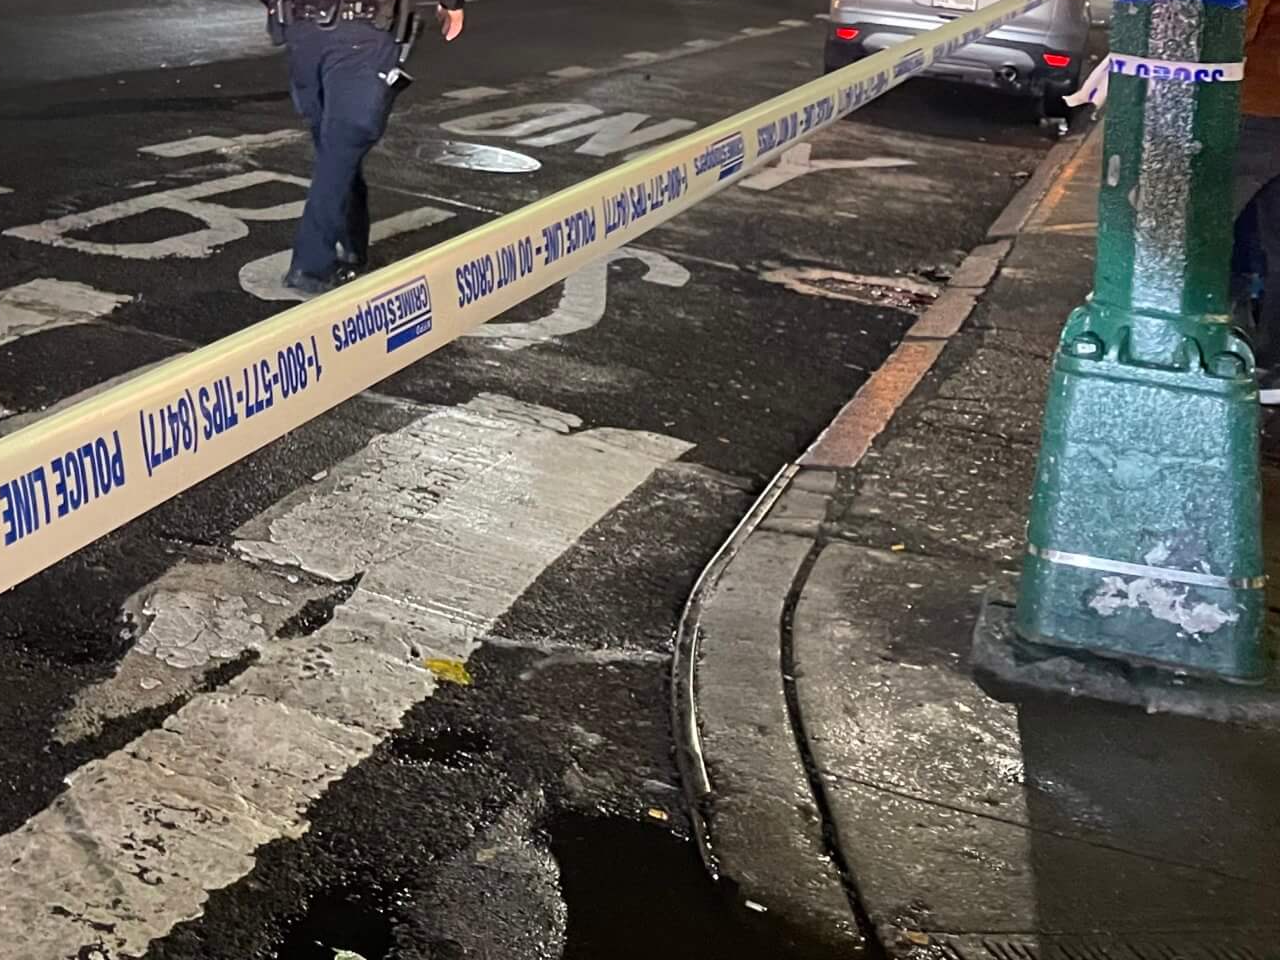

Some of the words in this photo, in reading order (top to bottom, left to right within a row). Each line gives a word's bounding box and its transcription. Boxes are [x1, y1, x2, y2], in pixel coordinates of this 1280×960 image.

[542, 222, 565, 266] LINE
[565, 206, 596, 254] POLICE
[455, 254, 494, 308] CROSS
[496, 244, 517, 288] NOT
[518, 236, 534, 278] DO
[198, 335, 323, 440] 1-800-577-TIPS
[140, 388, 198, 477] (8477)
[52, 430, 125, 518] POLICE
